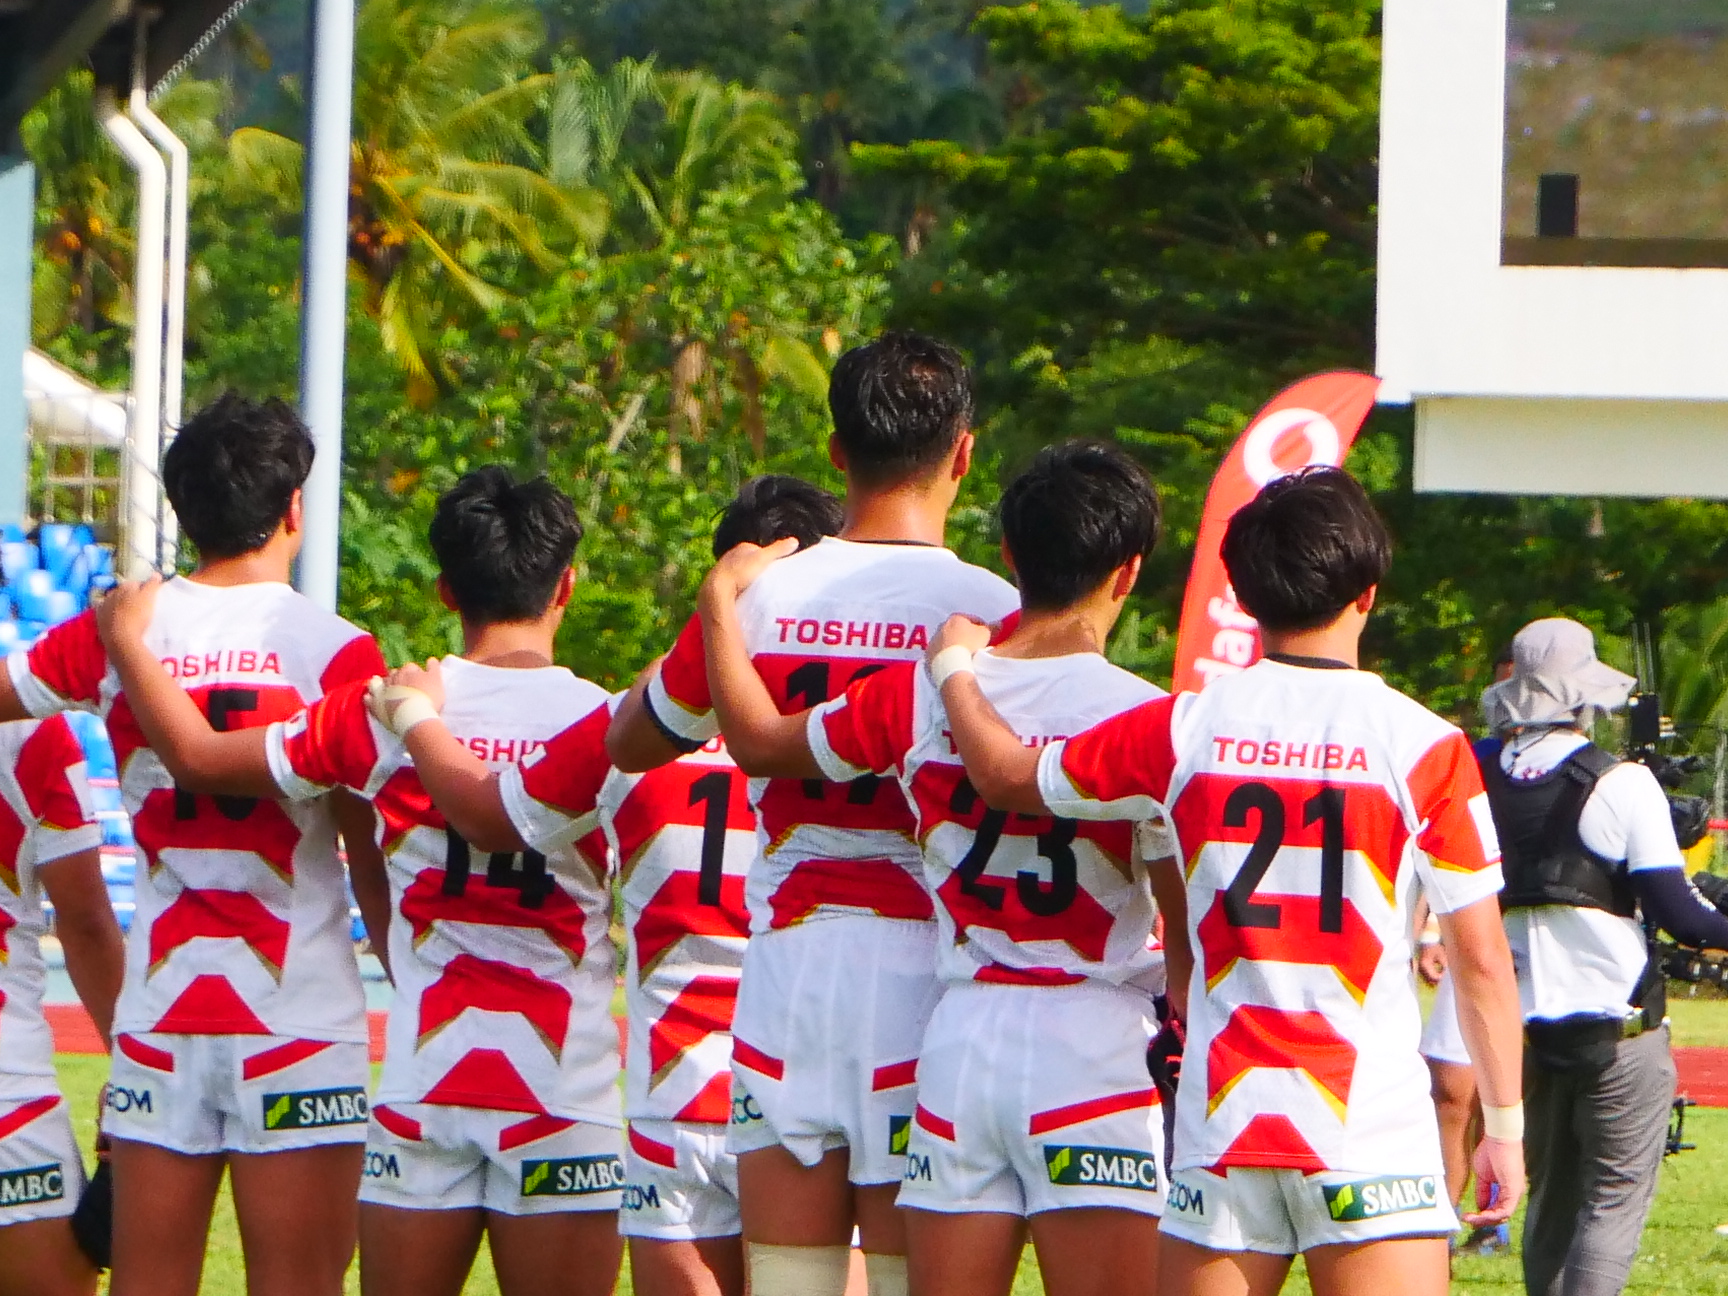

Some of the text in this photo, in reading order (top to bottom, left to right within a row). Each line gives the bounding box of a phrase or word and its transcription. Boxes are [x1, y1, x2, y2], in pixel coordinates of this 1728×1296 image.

[775, 618, 928, 650] TOSHIBA
[160, 650, 280, 678] OSHIBA
[1213, 736, 1368, 771] TOSHIBA
[689, 772, 733, 907] 1
[950, 778, 1078, 916] 23
[1222, 781, 1346, 935] 21
[299, 1092, 369, 1125] SMBC
[557, 1160, 627, 1191] SMBC
[1080, 1152, 1157, 1190] SMBC
[1361, 1177, 1437, 1216] SMBC
